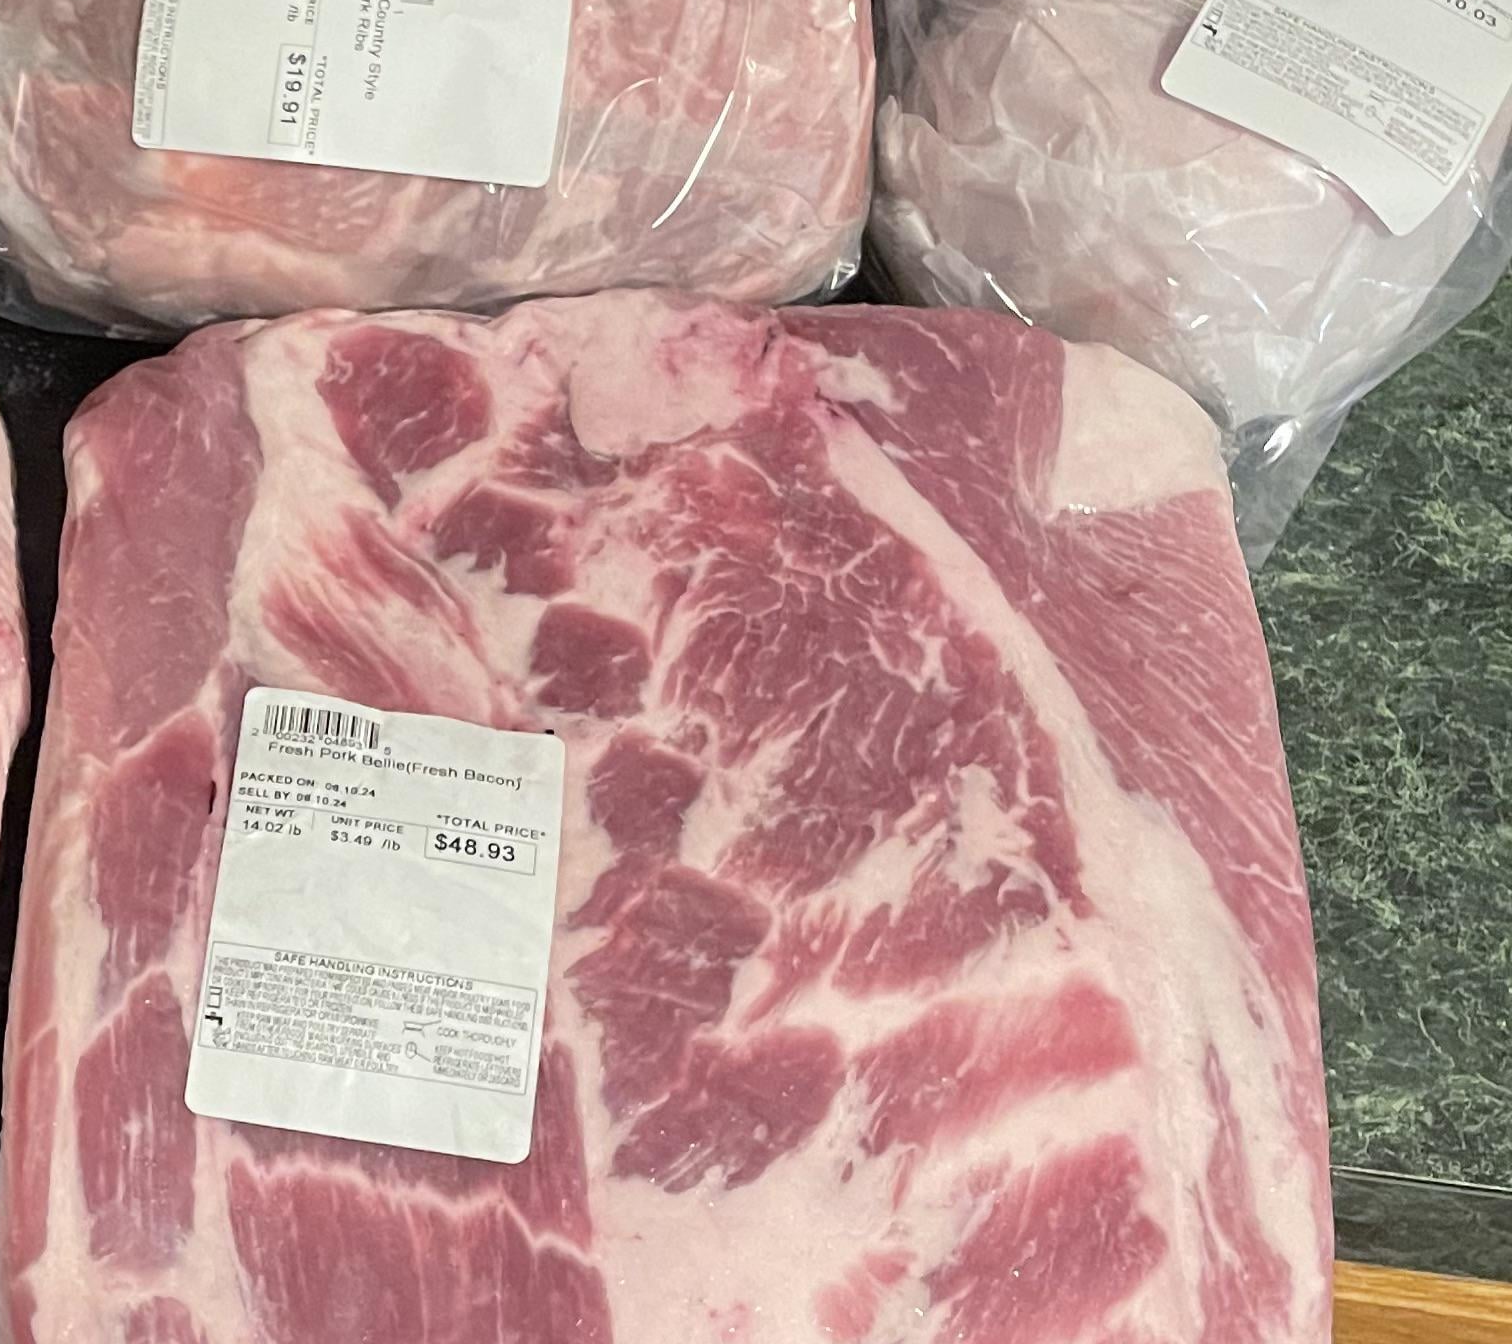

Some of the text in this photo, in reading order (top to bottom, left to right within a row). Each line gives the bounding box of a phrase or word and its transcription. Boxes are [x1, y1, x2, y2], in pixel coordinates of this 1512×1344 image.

[354, 18, 368, 52] Ribs
[369, 0, 391, 58] Country
[156, 6, 177, 90] INSTRUCTIONS
[280, 53, 306, 125] $19.91
[364, 63, 381, 100] Style
[251, 727, 259, 737] 2
[276, 731, 315, 744] 00232
[240, 772, 292, 785] PACKED
[268, 742, 314, 758] Fresh
[320, 748, 356, 763] Pork
[464, 770, 522, 790] Bacon)
[238, 787, 269, 798] SELL
[274, 791, 290, 800] BY
[246, 805, 295, 818] NET WT
[331, 815, 404, 834] UNIT PRICE
[243, 819, 302, 836] 14.02 lb
[330, 830, 400, 852] $3.49 /lb
[434, 833, 515, 862] $48.93
[274, 952, 473, 991] SAFE HANDLING INSTRUCTIONS
